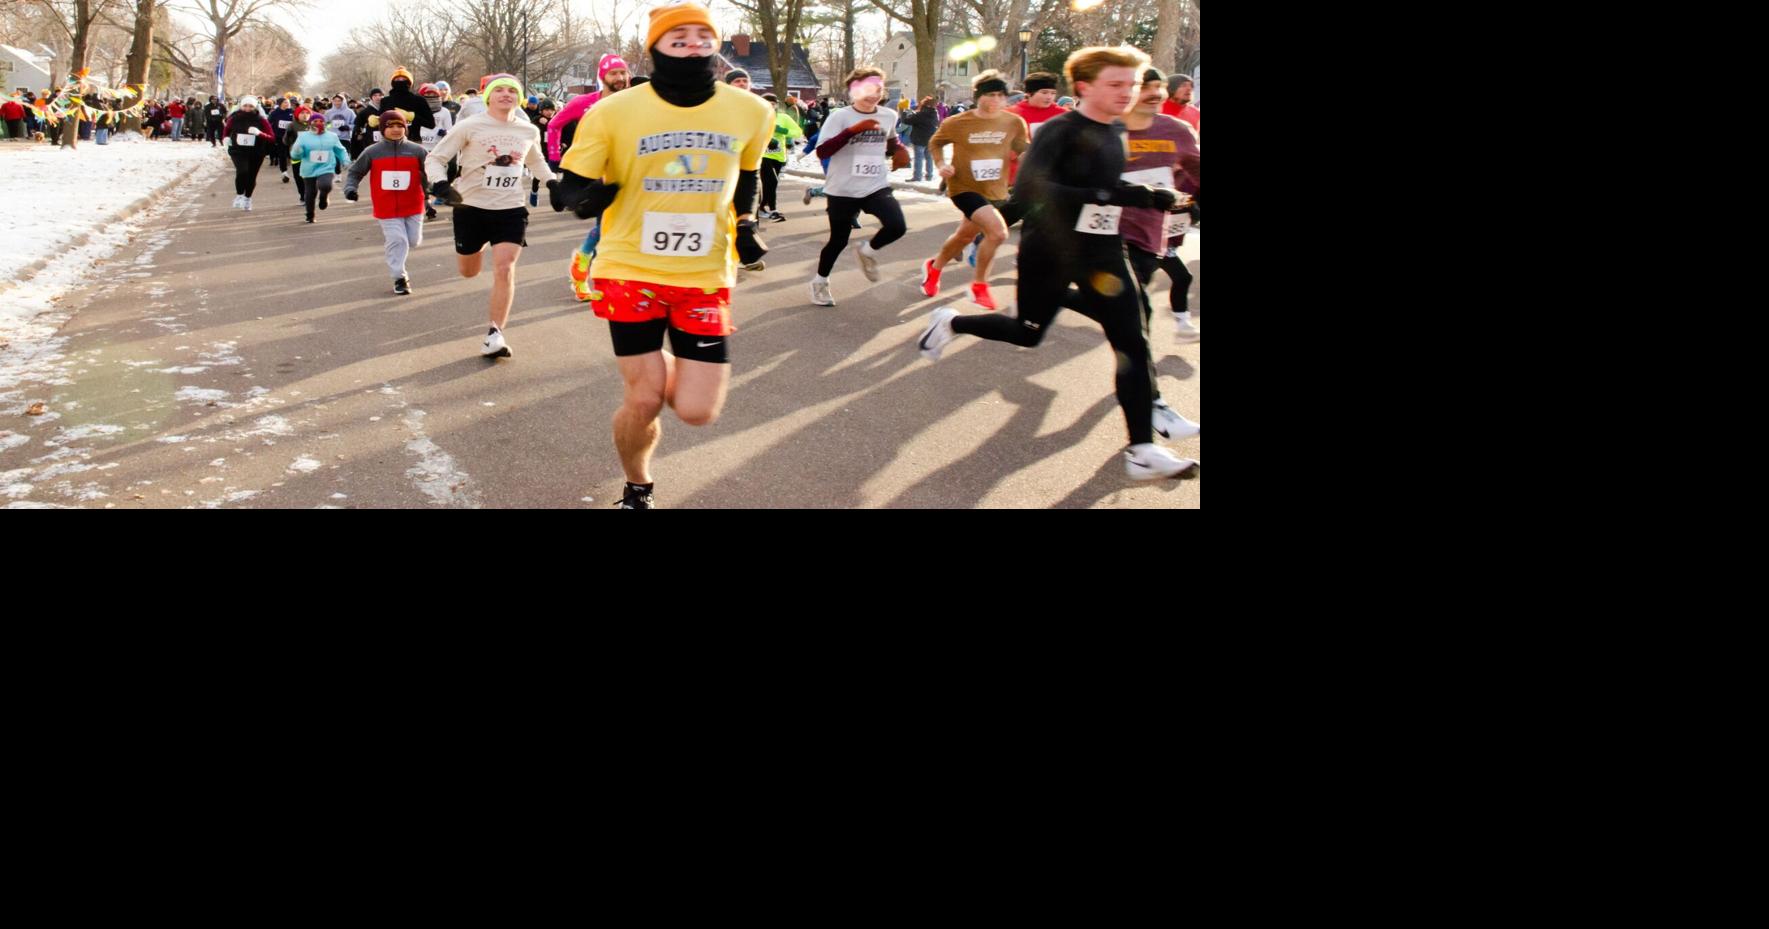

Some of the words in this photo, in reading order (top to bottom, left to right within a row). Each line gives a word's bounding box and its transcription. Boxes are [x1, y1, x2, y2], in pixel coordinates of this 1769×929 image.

[638, 131, 740, 155] AUGUSTAN
[392, 179, 400, 189] 8
[486, 176, 518, 188] 1187
[643, 178, 725, 193] UNIVERSITY
[653, 231, 702, 252] 973
